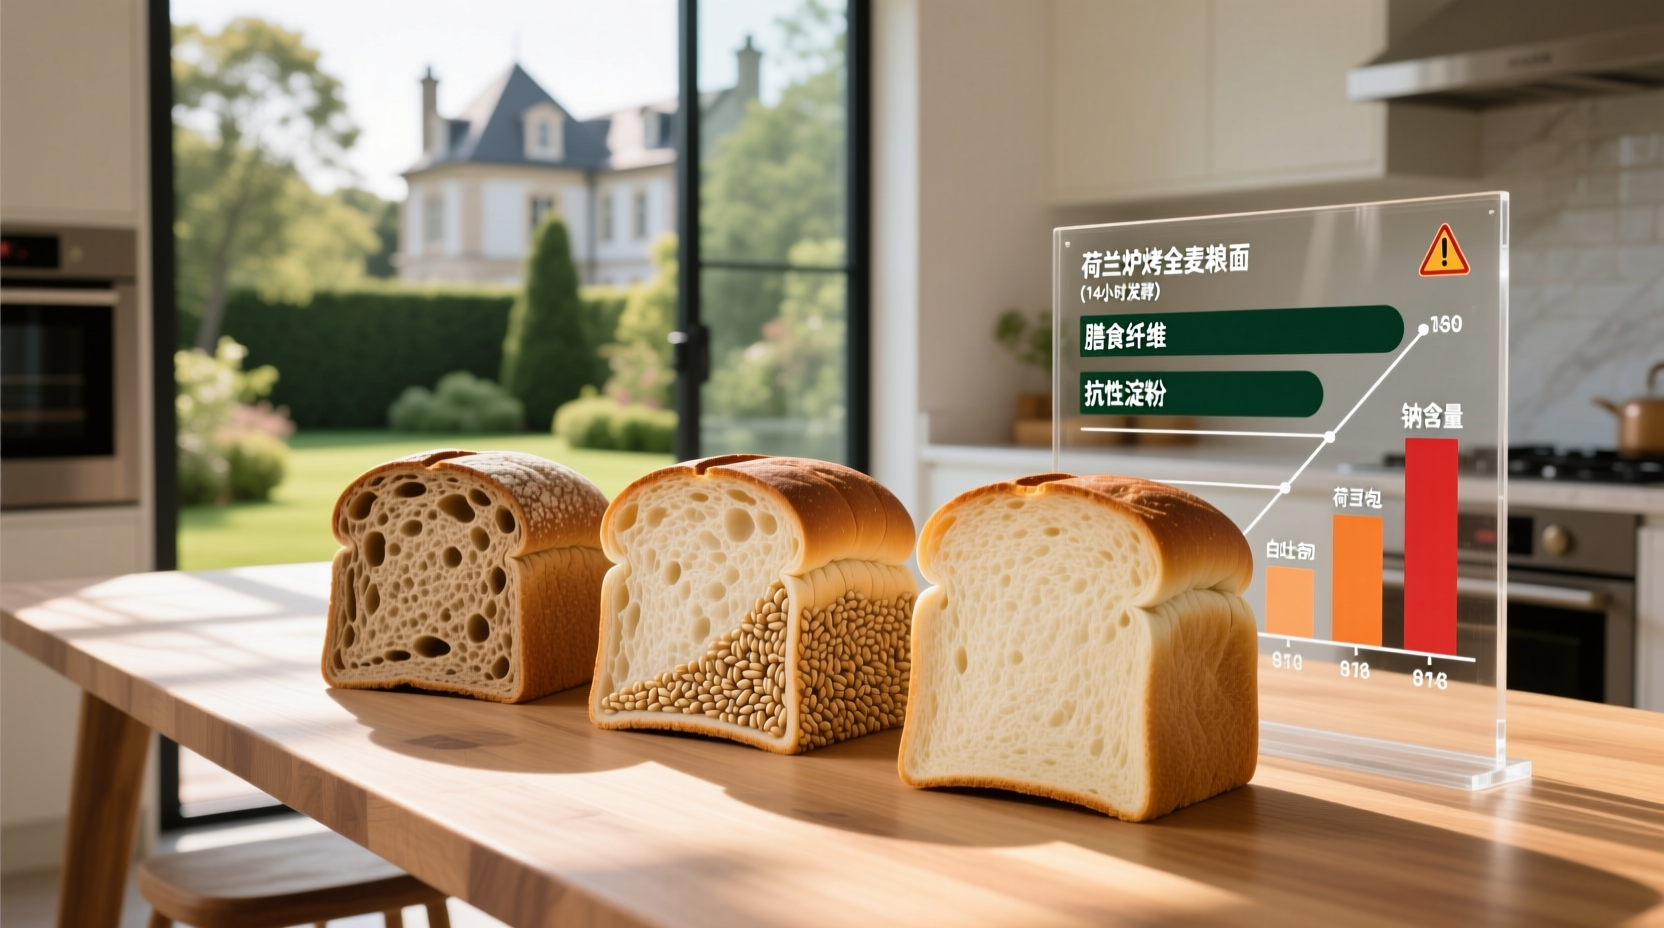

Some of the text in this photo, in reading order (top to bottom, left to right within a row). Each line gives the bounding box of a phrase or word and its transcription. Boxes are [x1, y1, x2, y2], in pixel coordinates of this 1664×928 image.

[1084, 321, 1167, 350] 膳食纤维
[1084, 378, 1167, 407] 抗性淀粉
[1401, 402, 1463, 429] 钠含量
